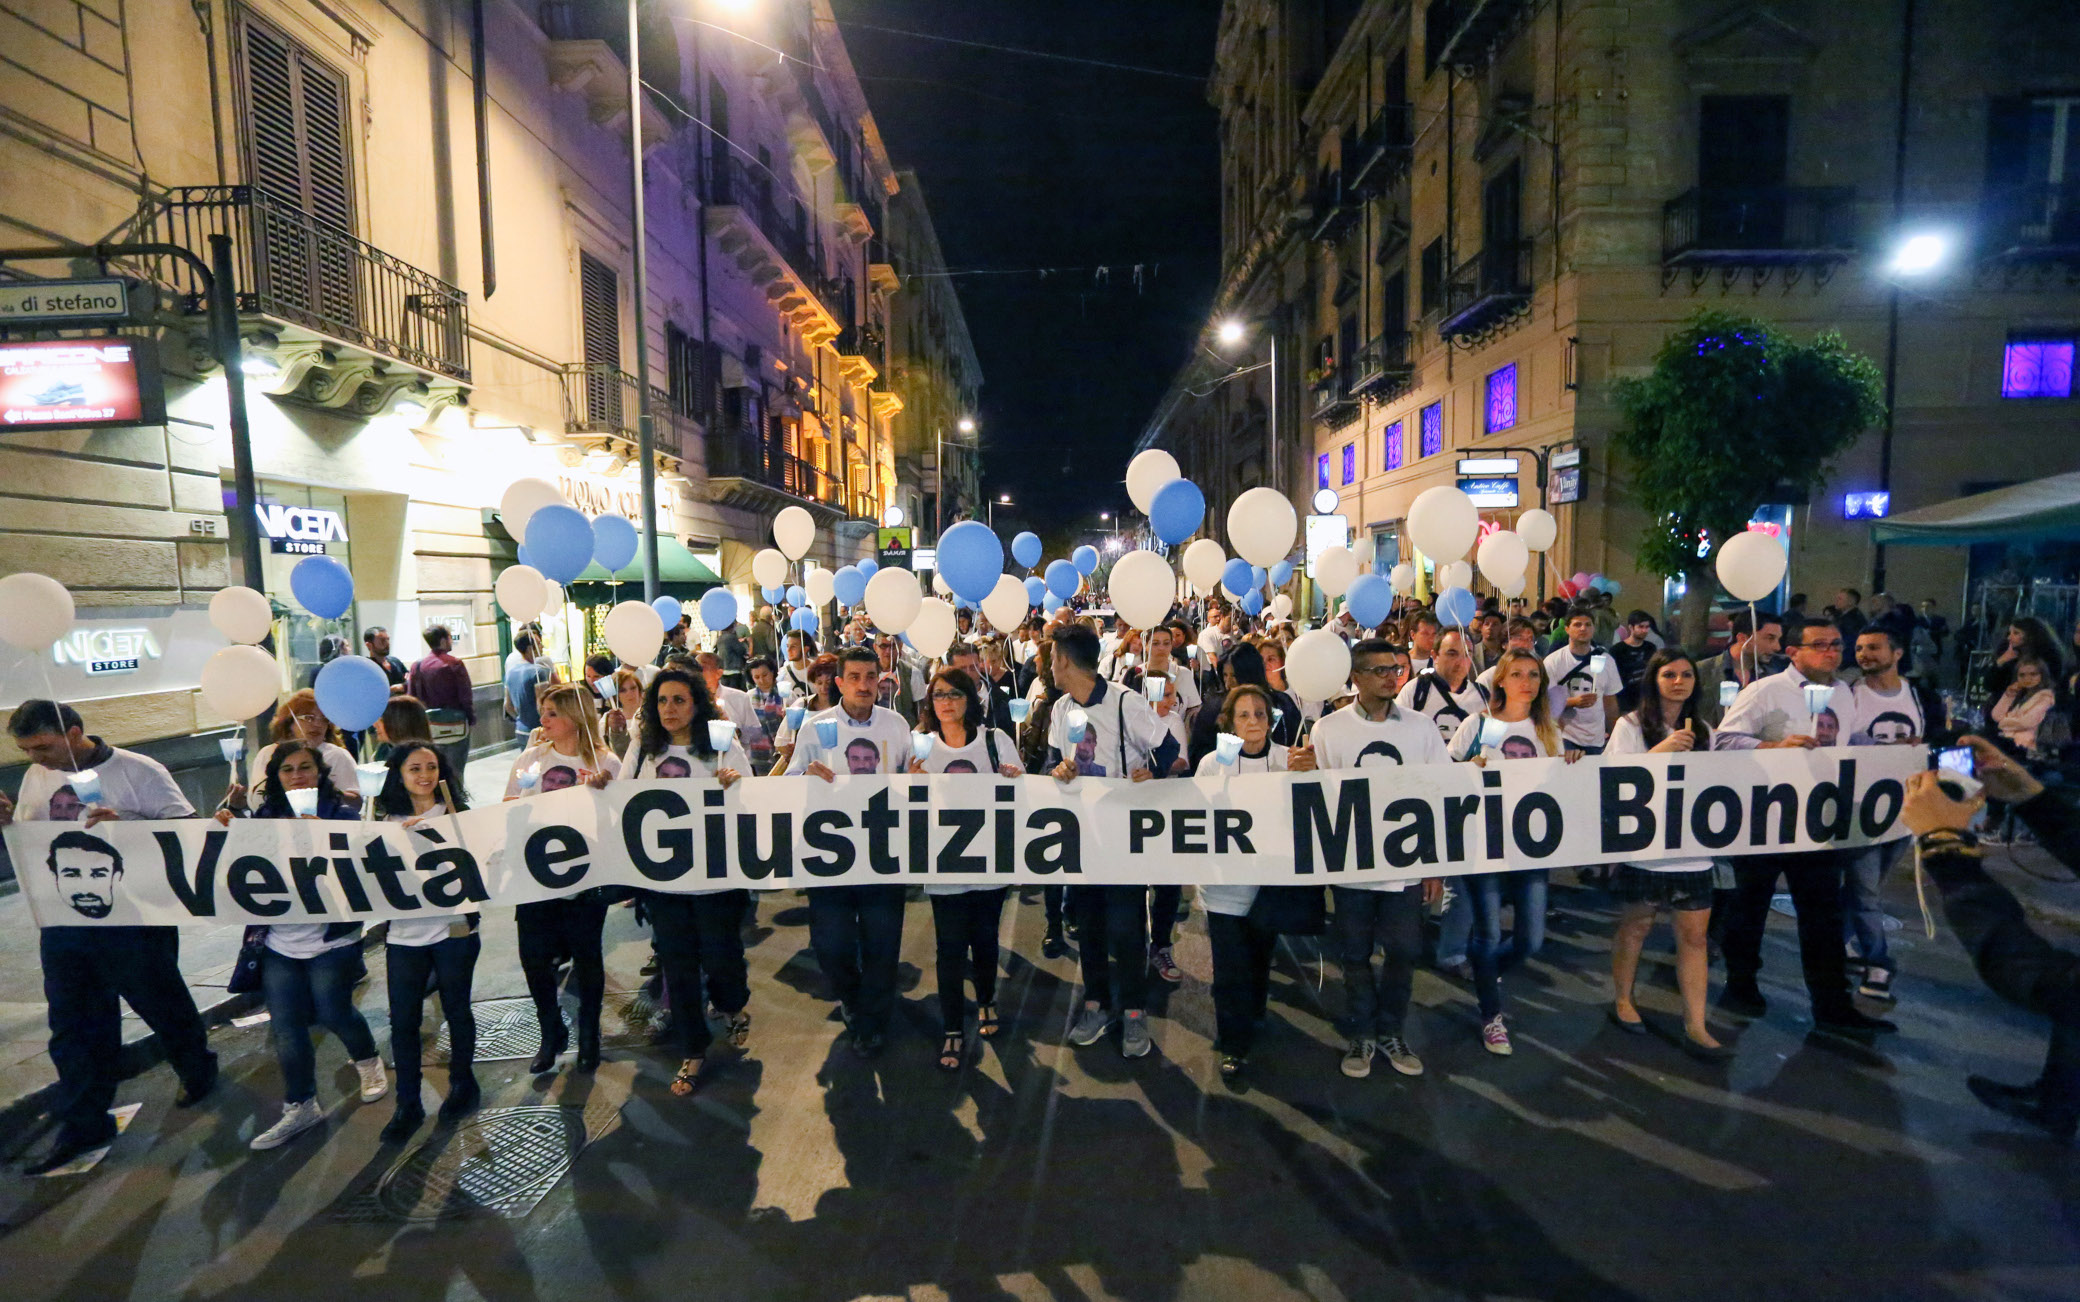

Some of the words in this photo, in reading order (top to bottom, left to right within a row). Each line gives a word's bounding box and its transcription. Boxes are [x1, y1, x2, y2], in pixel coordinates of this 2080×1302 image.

[21, 296, 38, 312] di
[46, 294, 117, 312] stefano
[255, 503, 349, 542] NICETA
[285, 542, 324, 554] STORE
[53, 628, 161, 664] NICETA
[94, 660, 135, 671] STORE
[153, 827, 490, 917] Verità
[524, 825, 591, 889] e
[621, 785, 1083, 882] Giustizia
[1129, 809, 1257, 854] PER
[1291, 770, 1564, 875] Mario
[1599, 759, 1904, 854] Biondo
